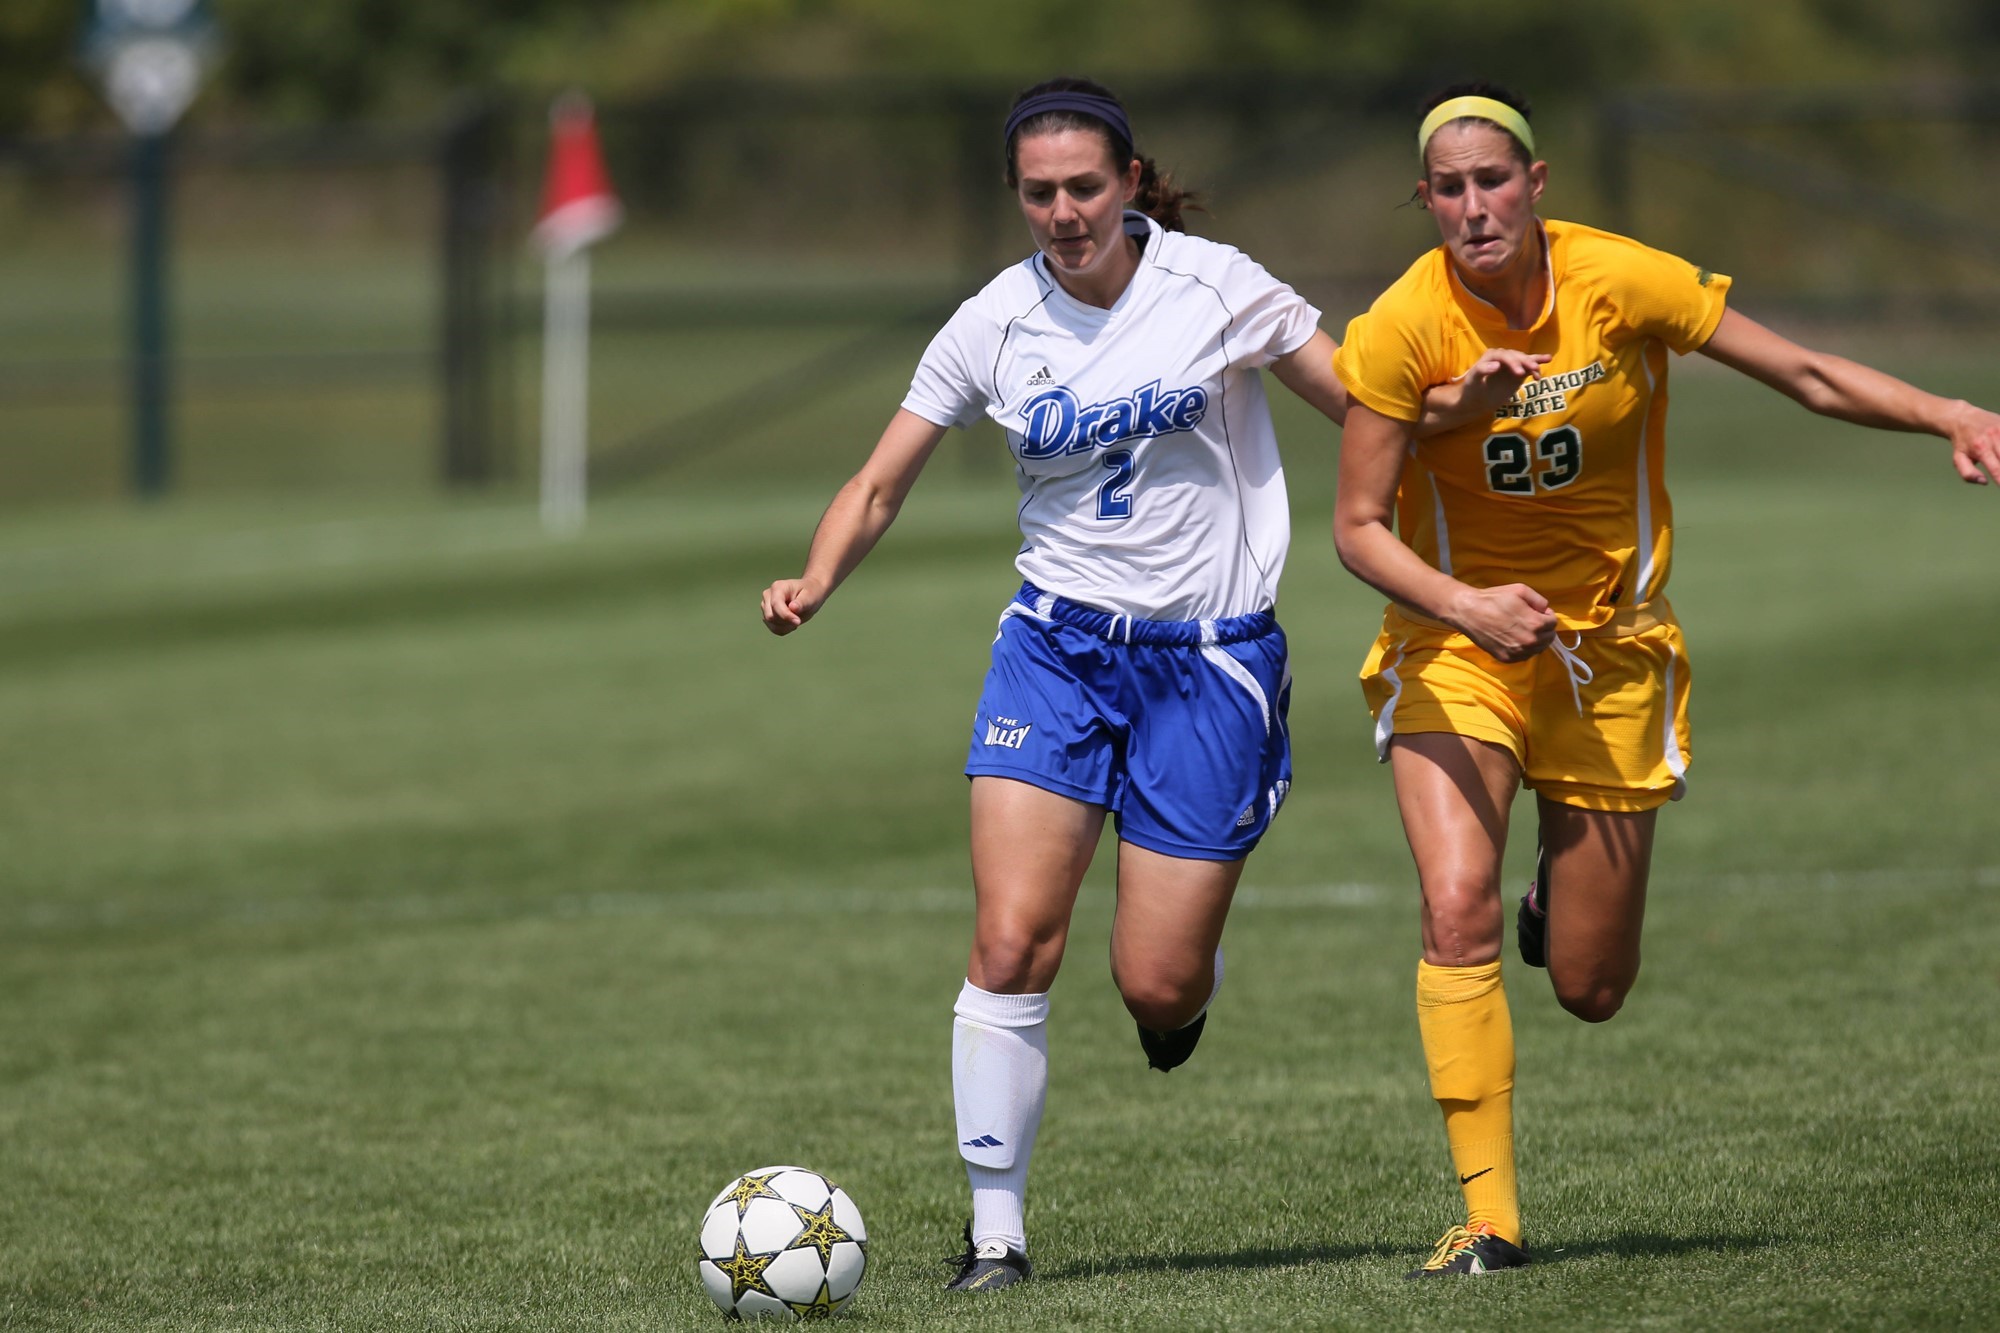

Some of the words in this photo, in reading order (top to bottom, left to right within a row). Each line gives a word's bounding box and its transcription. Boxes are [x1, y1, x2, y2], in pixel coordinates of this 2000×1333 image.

[1026, 377, 1056, 386] adidas
[1522, 360, 1605, 400] DAKOTA
[1018, 378, 1209, 460] Drake
[1495, 392, 1567, 419] STATE
[1483, 423, 1583, 496] 23
[1096, 449, 1136, 521] 2
[996, 715, 1019, 727] THE
